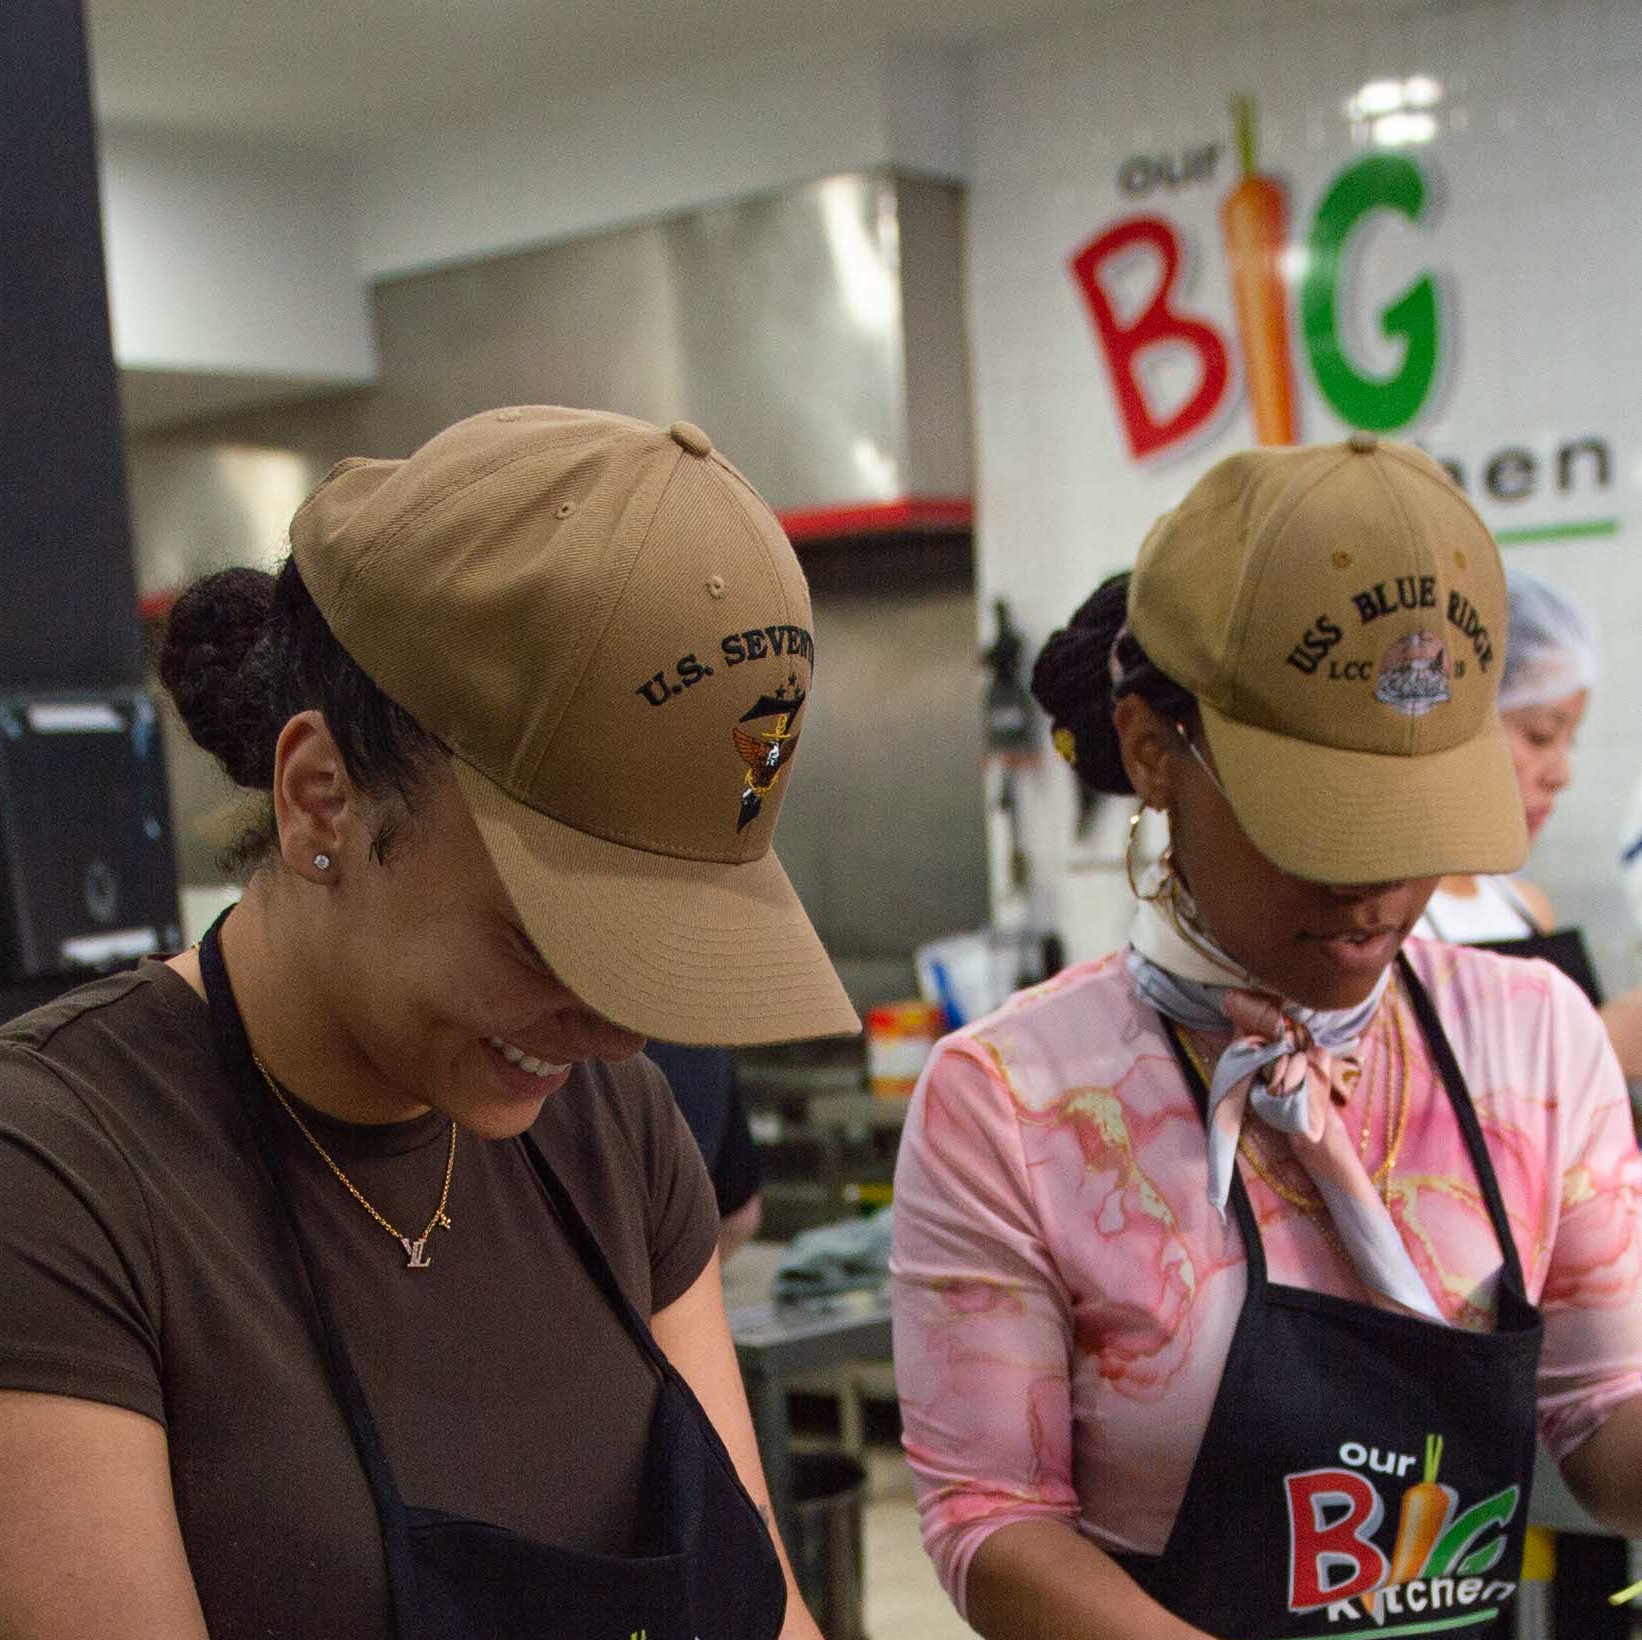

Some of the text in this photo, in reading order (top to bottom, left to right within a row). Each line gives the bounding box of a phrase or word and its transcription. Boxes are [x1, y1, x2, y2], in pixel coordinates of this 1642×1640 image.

[1285, 575, 1494, 675] USS BLUE RIDGE
[635, 653, 714, 707] U.S.
[1328, 659, 1374, 681] LCC
[1338, 1441, 1416, 1478] our
